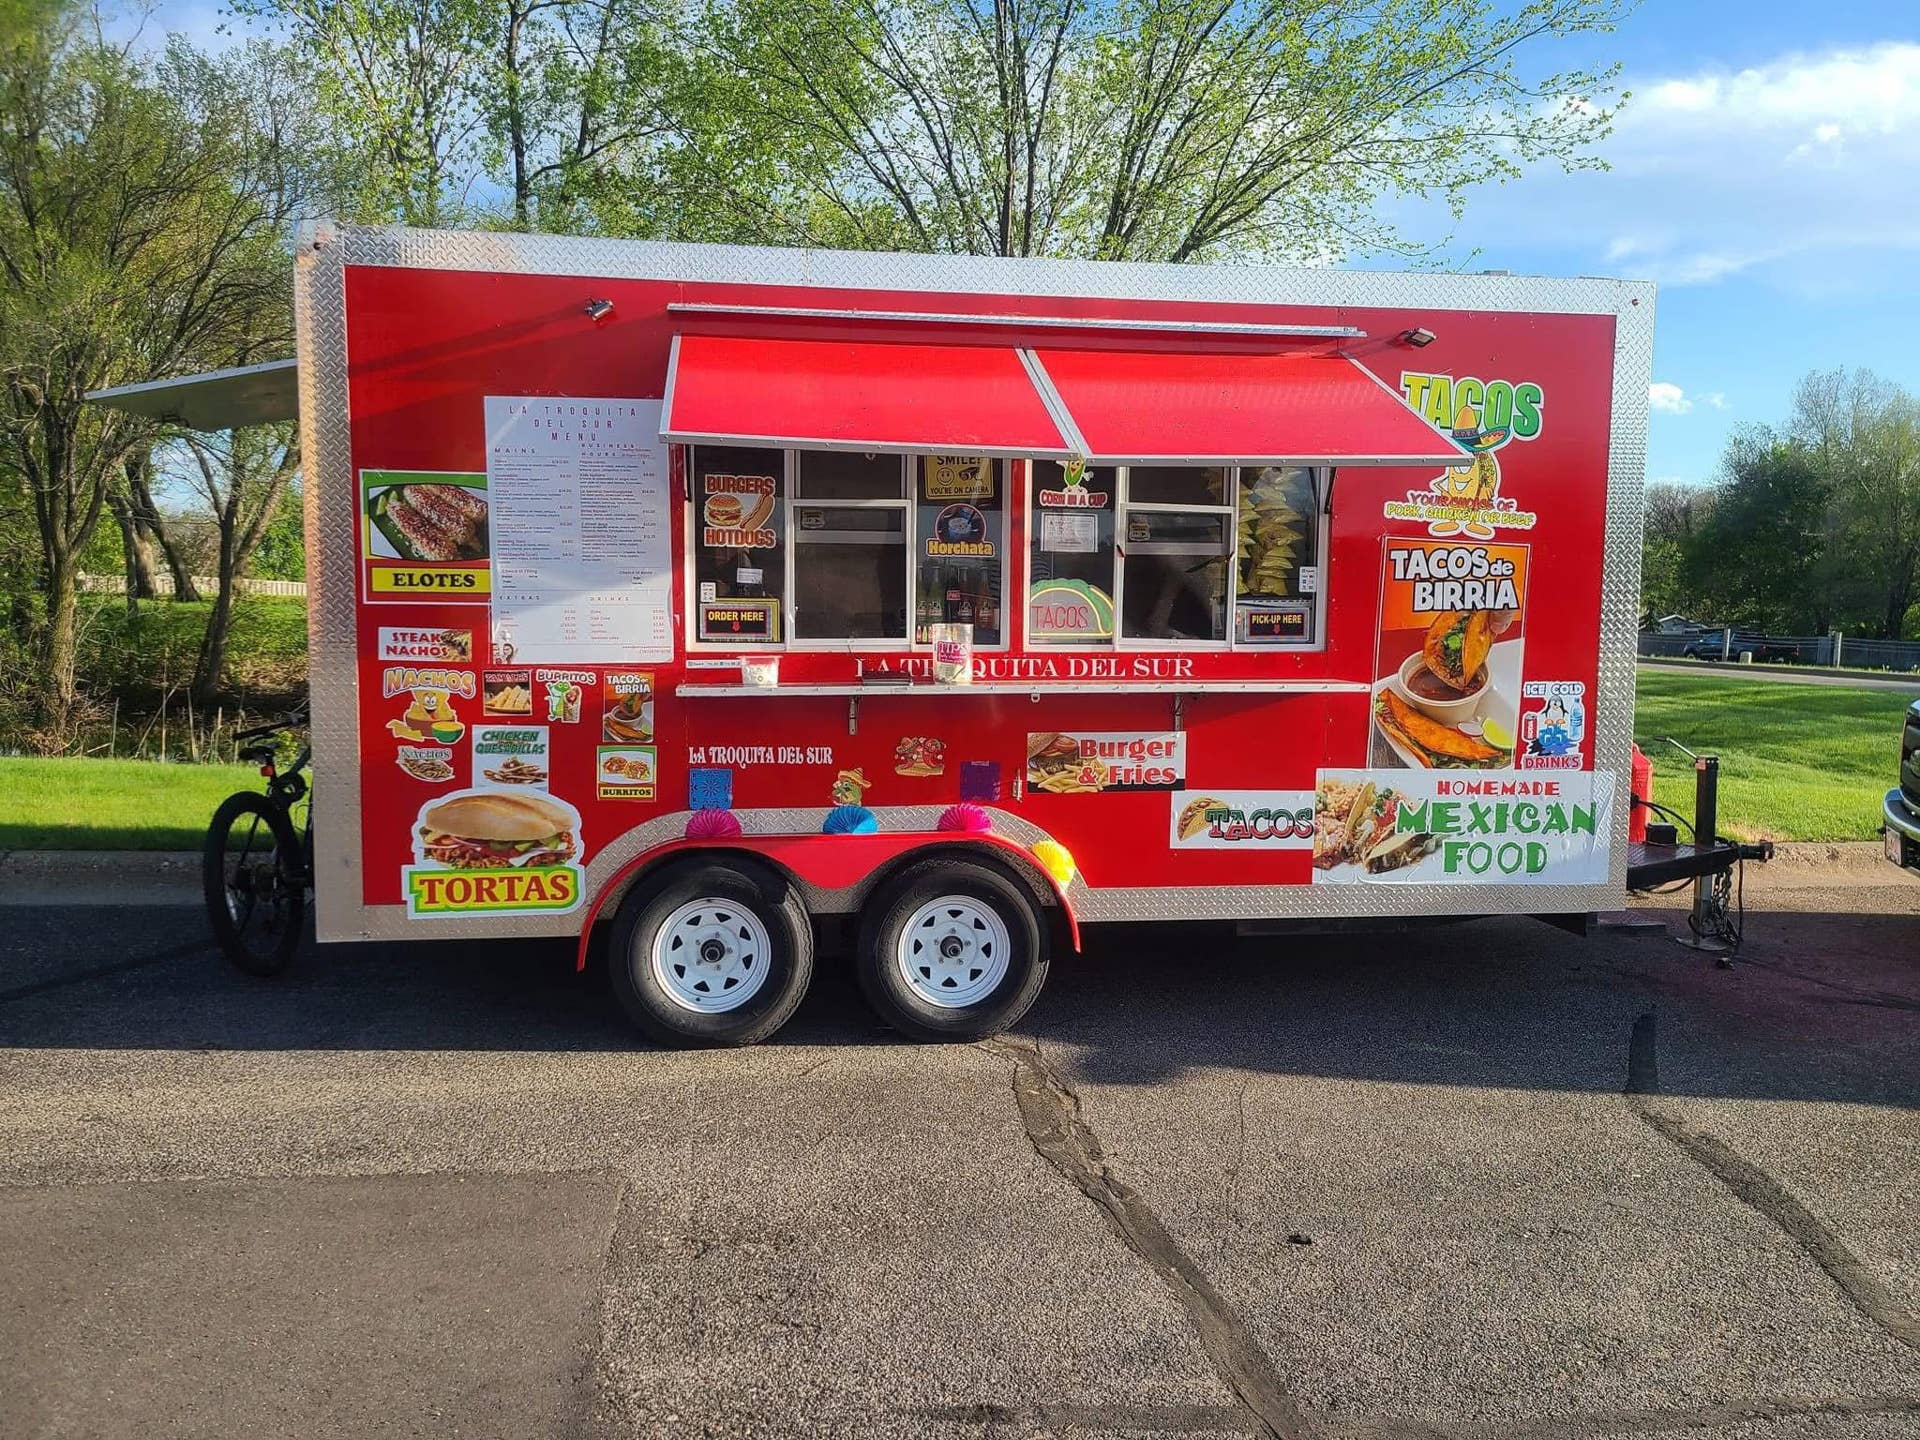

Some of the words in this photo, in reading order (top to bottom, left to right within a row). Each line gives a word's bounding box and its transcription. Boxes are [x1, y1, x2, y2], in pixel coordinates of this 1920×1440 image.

[509, 405, 527, 415] LA
[545, 406, 636, 417] TROQUITA
[1403, 373, 1541, 438] TACOS
[534, 419, 565, 428] DEL
[582, 420, 612, 429] SUR
[551, 432, 596, 441] MENU
[706, 475, 775, 495] BURGERS
[1409, 493, 1449, 507] YOUR
[1497, 499, 1514, 512] OF
[1425, 506, 1480, 522] CHICKEN
[1481, 510, 1500, 523] OR
[705, 528, 775, 547] HOTDOGS
[928, 540, 993, 555] Horchata
[1390, 548, 1489, 580] TACOS
[1489, 559, 1514, 576] de
[392, 573, 476, 588] ELOTES
[1413, 579, 1519, 612] BIRRIA
[708, 611, 739, 621] ORDER
[740, 611, 765, 621] HERE
[1033, 605, 1089, 629] TACOS
[1252, 614, 1281, 624] PICK-UP
[1283, 614, 1302, 624] HERE
[392, 632, 442, 642] STEAK
[386, 645, 449, 656] NACHOS
[855, 657, 890, 677] LA
[900, 657, 1060, 678] TQUITA
[1067, 657, 1126, 677] DEL
[1133, 657, 1193, 678] SUR
[385, 668, 474, 696] NACHOS
[537, 670, 595, 684] BURRITOS
[605, 674, 641, 685] TACOS
[614, 684, 651, 694] BIRRIA
[1526, 683, 1546, 695] ICE
[1551, 683, 1583, 695] COLD
[482, 731, 540, 742] CHICKEN
[475, 743, 546, 754] QUESADILLAS
[1079, 739, 1176, 763] Burger
[689, 746, 706, 764] LA
[709, 746, 775, 769] TROQUITA
[777, 746, 804, 764] DEL
[806, 746, 833, 764] SUR
[1525, 756, 1579, 769] DRINKS
[1078, 766, 1098, 784] &
[1108, 765, 1177, 785] Fries
[602, 788, 652, 796] BURRITOS
[1436, 780, 1560, 796] HOMEMADE
[1205, 808, 1313, 840] TACOS
[1395, 800, 1598, 836] MEXICAN
[1443, 842, 1548, 874] FOOD
[419, 874, 570, 905] TORTAS
